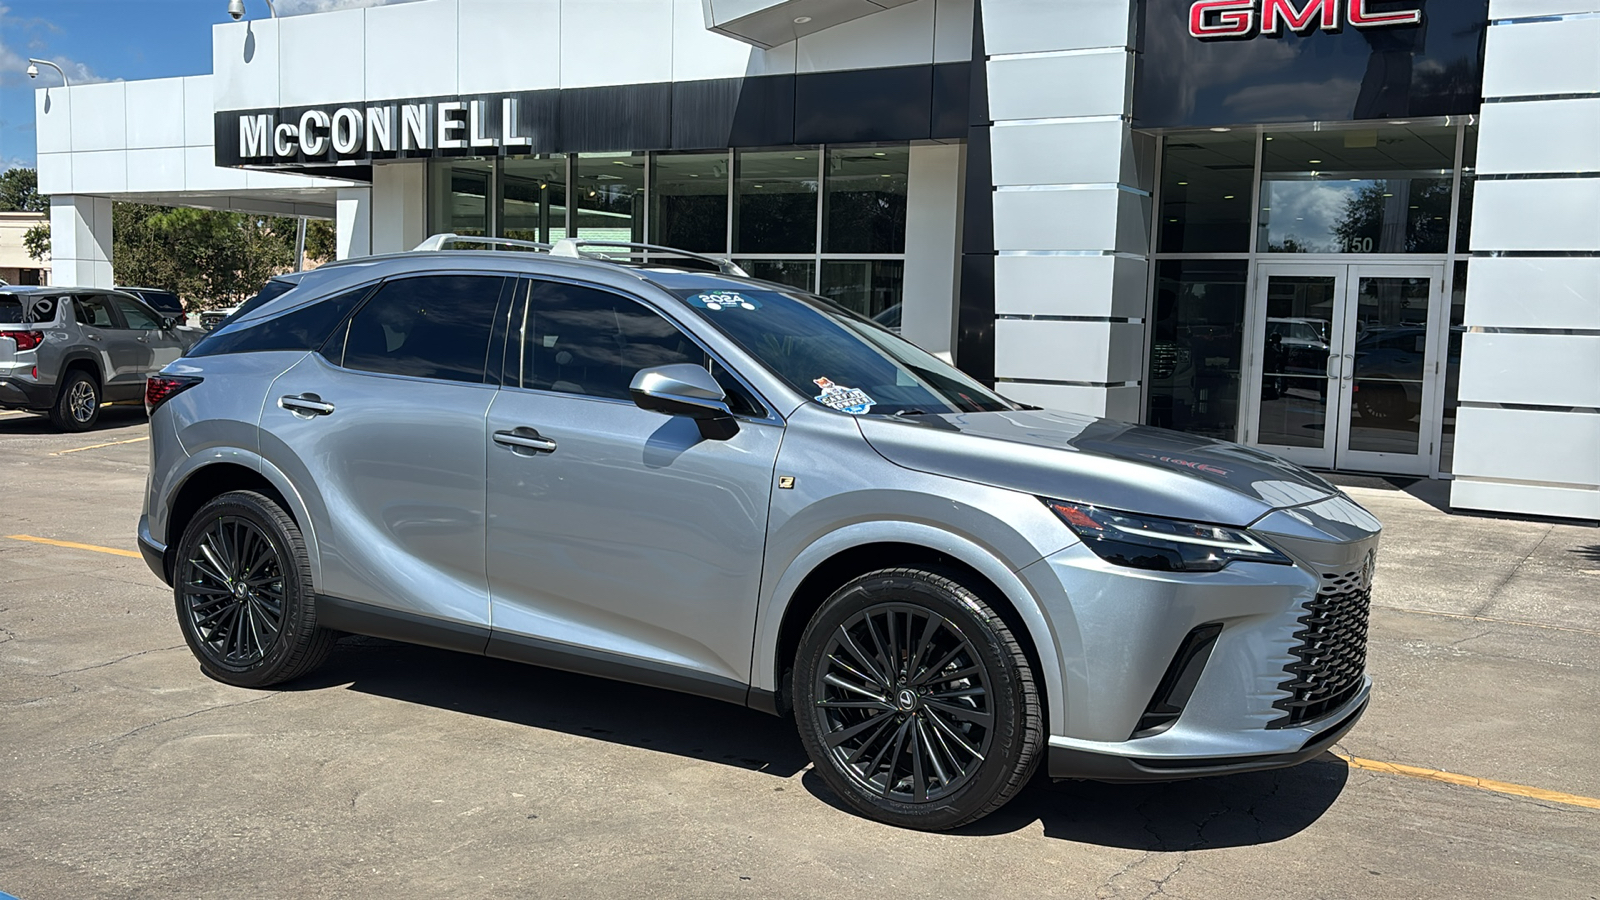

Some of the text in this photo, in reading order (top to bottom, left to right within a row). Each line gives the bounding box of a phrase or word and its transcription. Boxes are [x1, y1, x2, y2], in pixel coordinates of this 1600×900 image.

[1189, 0, 1422, 39] GMC
[698, 294, 745, 303] 2024
[821, 391, 865, 405] CARFAX
